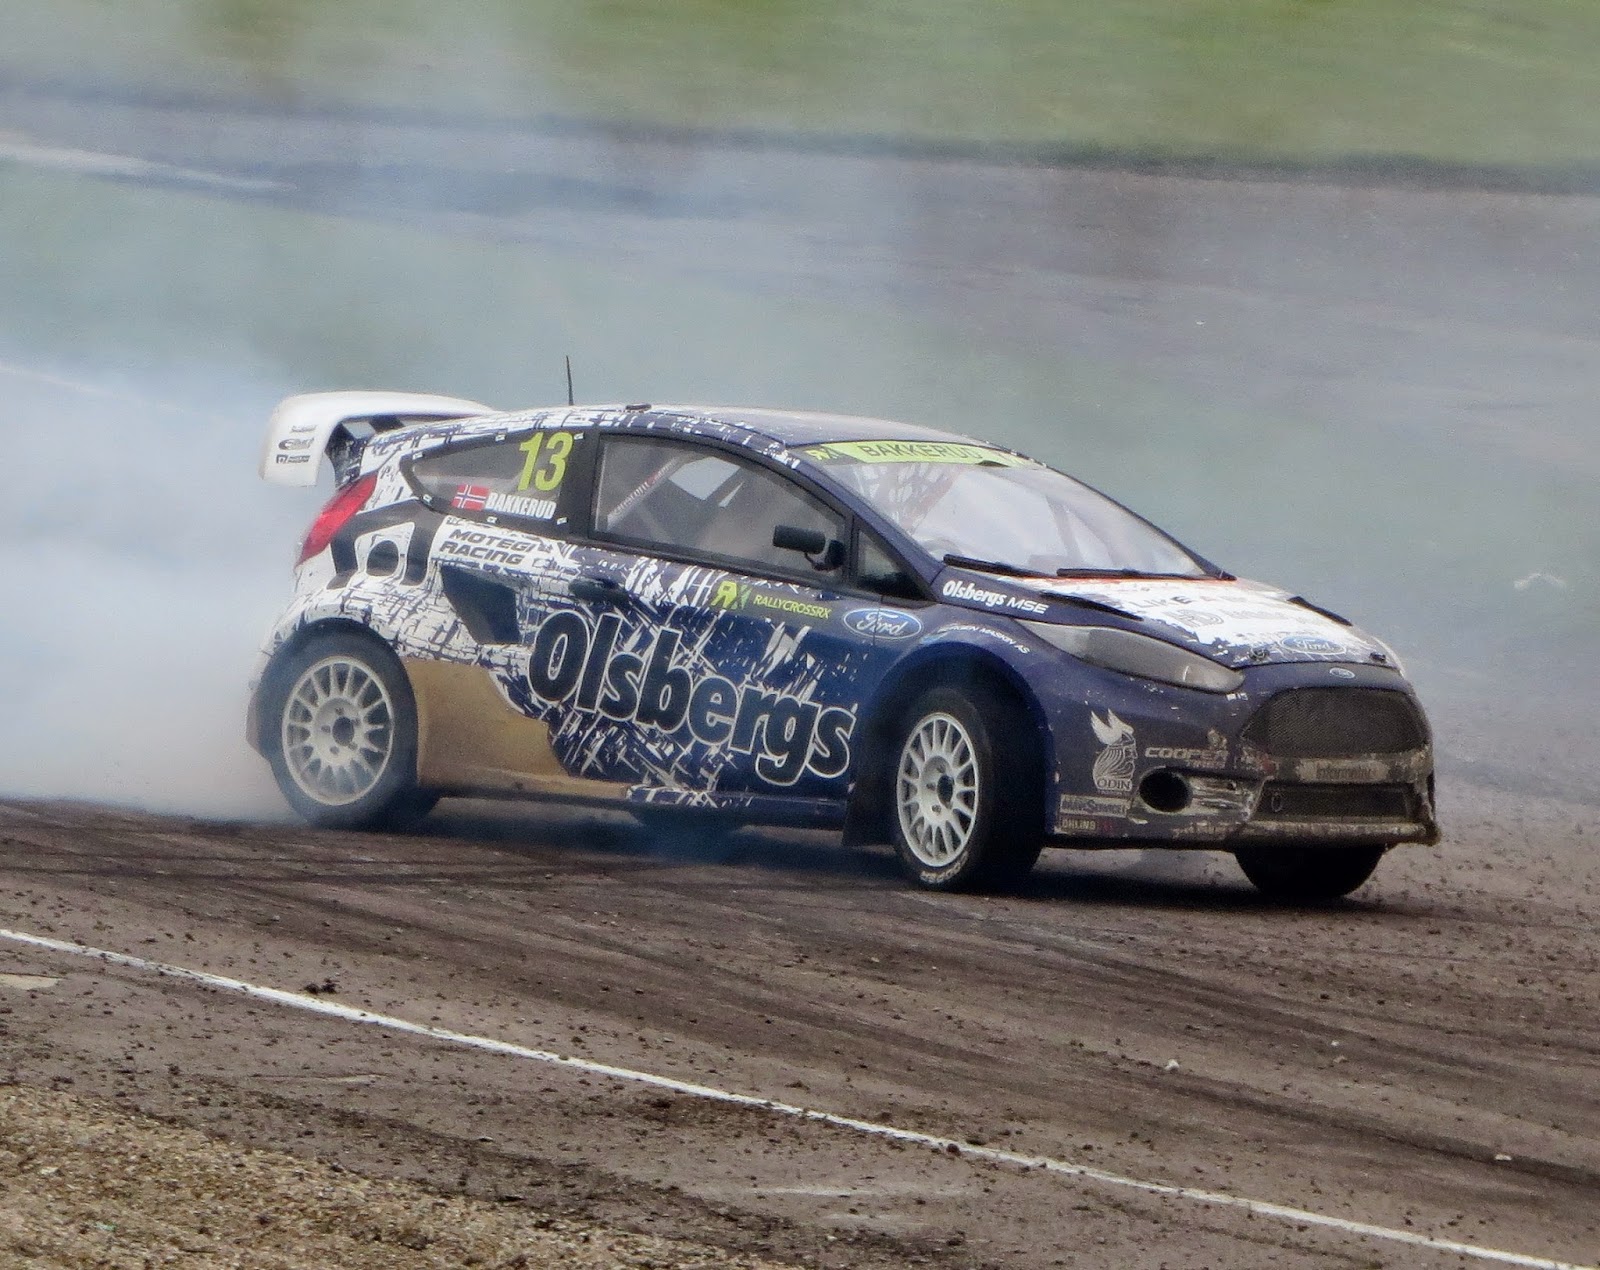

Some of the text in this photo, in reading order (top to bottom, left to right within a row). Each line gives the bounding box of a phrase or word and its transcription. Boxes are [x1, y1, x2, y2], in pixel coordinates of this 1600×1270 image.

[518, 431, 573, 492] 13
[858, 443, 983, 459] BAKKERUD
[485, 492, 557, 519] BAKKERUD
[439, 541, 526, 565] RACING
[449, 529, 538, 553] MOTEGI
[753, 595, 832, 619] RALLYCROSSRX
[942, 580, 1049, 614] Olsbergs MSE
[856, 609, 908, 634] Ford
[526, 609, 858, 786] Olsbergs
[1097, 778, 1131, 791] ODIN
